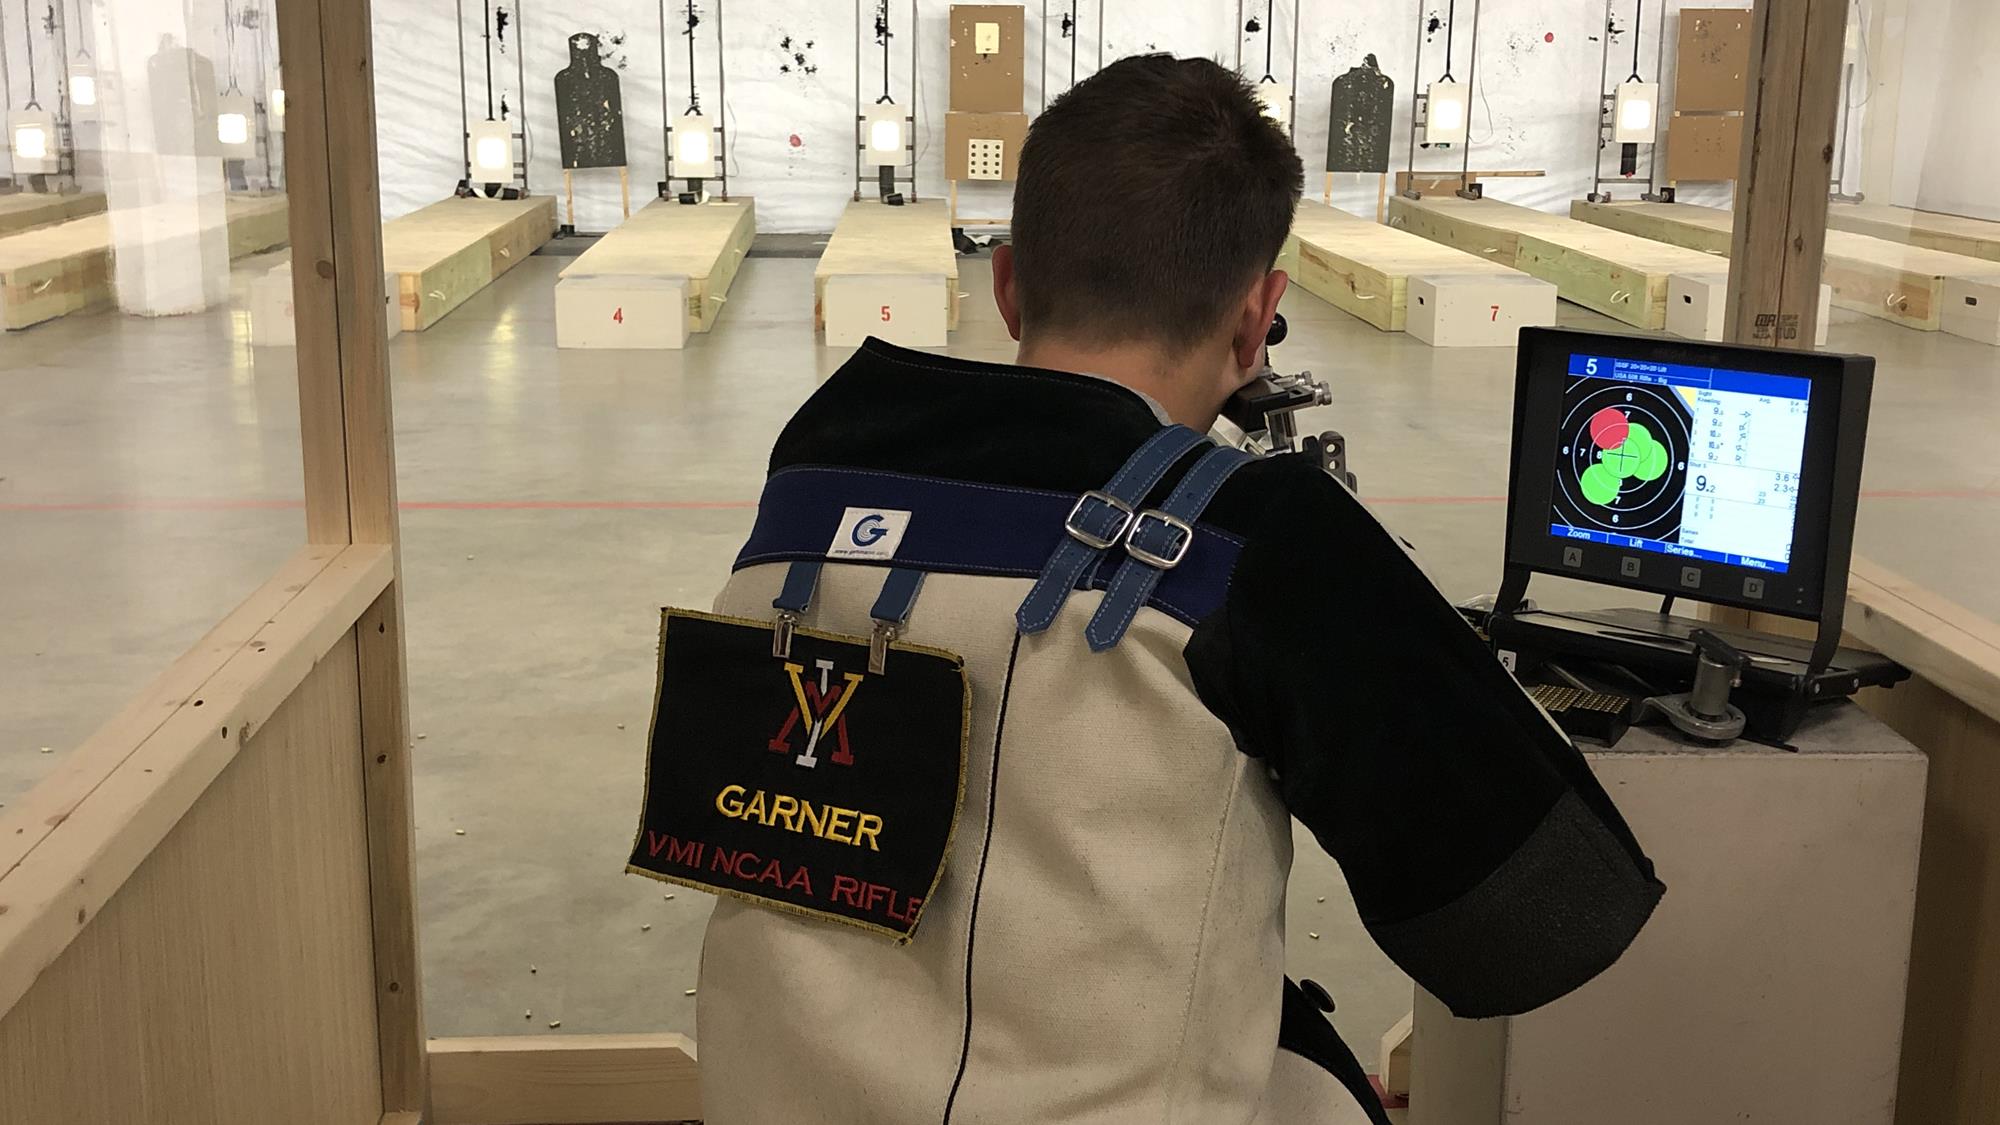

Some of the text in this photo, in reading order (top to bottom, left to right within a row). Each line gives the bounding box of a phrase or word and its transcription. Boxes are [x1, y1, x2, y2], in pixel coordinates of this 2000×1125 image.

[612, 307, 624, 324] 4
[880, 305, 891, 322] 5
[1490, 305, 1499, 322] 7
[1585, 358, 1598, 375] 5
[1626, 392, 1633, 402] 6
[1624, 410, 1631, 419] 7
[1562, 446, 1570, 455] 6
[1579, 448, 1587, 457] 7
[1677, 461, 1685, 471] 6
[1695, 475, 1716, 493] 9.2
[1615, 496, 1622, 505] 7
[1611, 514, 1619, 523] 6
[1566, 528, 1591, 540] Zoom
[1628, 537, 1644, 548] Lift
[1568, 551, 1577, 562] A
[1626, 561, 1635, 572] B
[1686, 571, 1695, 582] C
[1748, 582, 1758, 593] D
[715, 784, 884, 852] GARNER
[647, 830, 924, 926] VMI NCAA RIFLE
